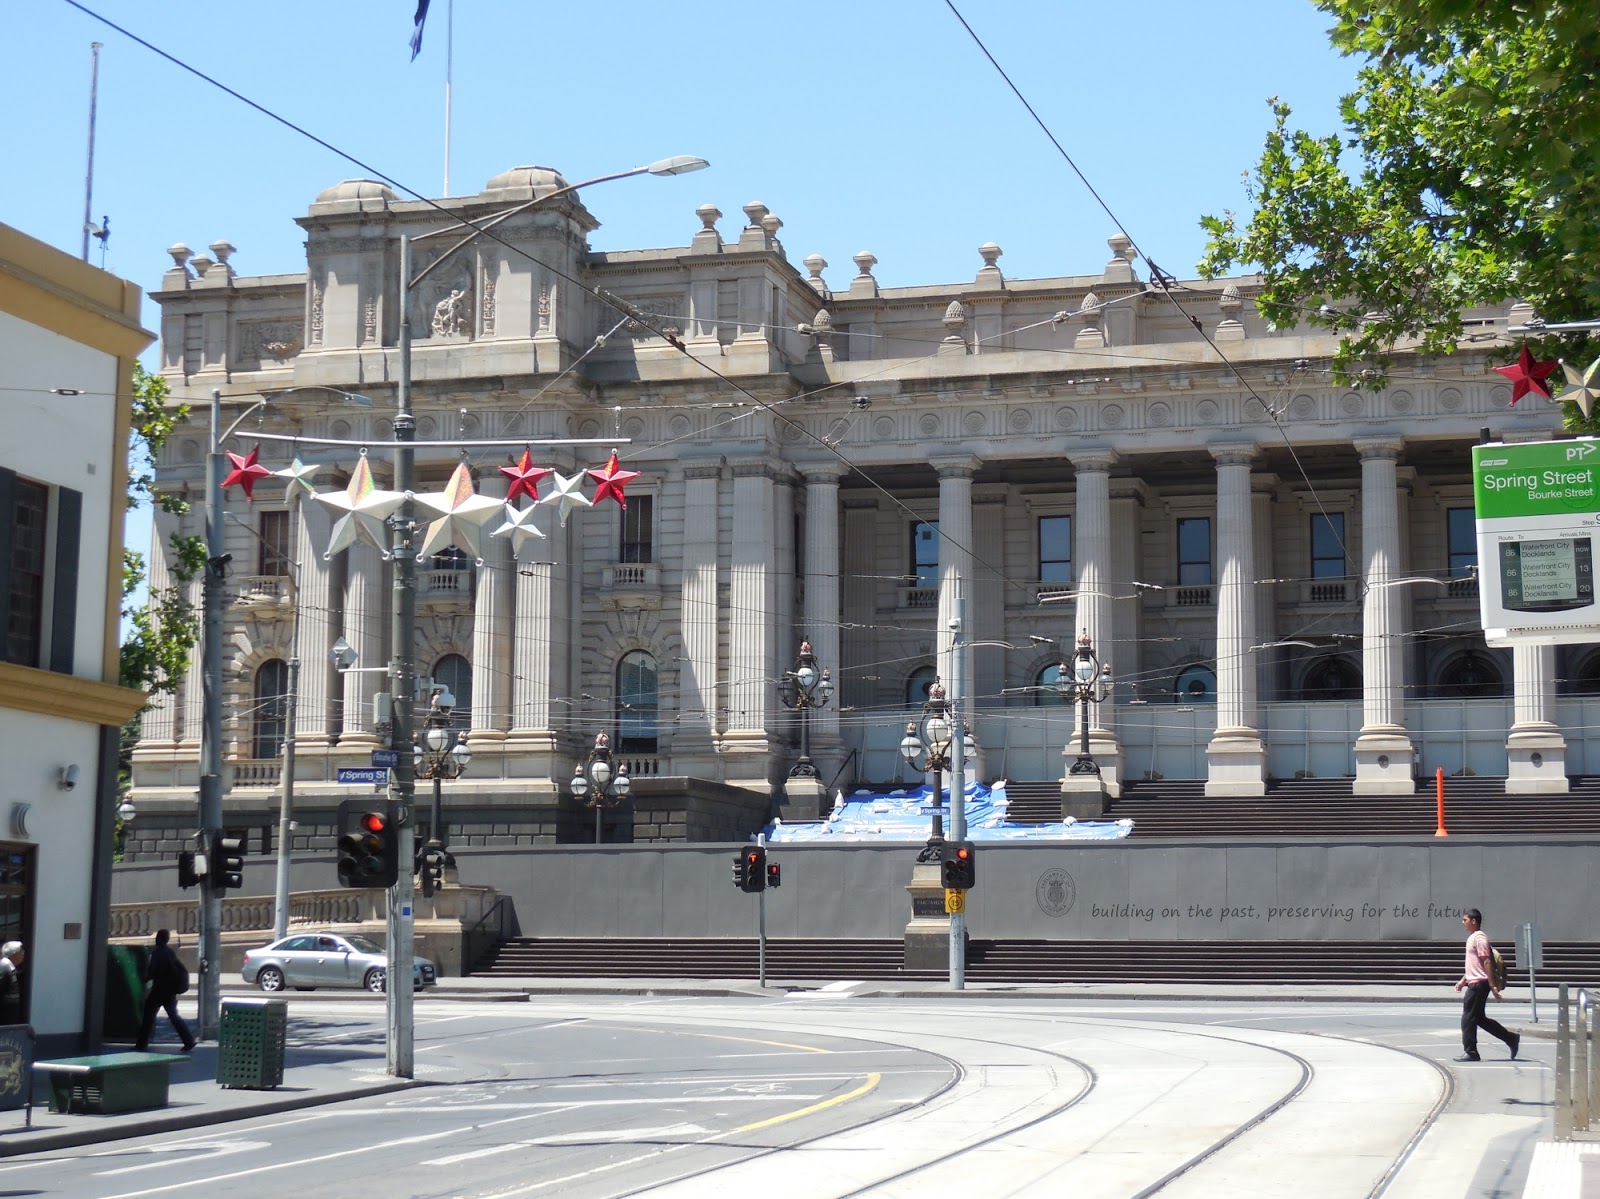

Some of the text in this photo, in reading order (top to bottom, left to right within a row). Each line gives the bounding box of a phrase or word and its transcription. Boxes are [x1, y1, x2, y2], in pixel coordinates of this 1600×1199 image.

[1484, 470, 1592, 491] Spring Street
[1528, 488, 1593, 500] Bourke Street
[1521, 542, 1569, 551] Waterfront City
[1505, 549, 1516, 557] 86
[1522, 550, 1556, 558] Docklands
[1523, 562, 1571, 571] Waterfront City
[1506, 569, 1517, 577] 86
[1523, 570, 1557, 578] Docklands
[1523, 582, 1572, 591] Waterfront City
[1580, 585, 1590, 593] 20
[1508, 589, 1518, 597] 86
[1524, 590, 1559, 598] Docklands
[346, 770, 386, 780] Spring St
[1092, 902, 1466, 922] building on the past, preserving for the futu
